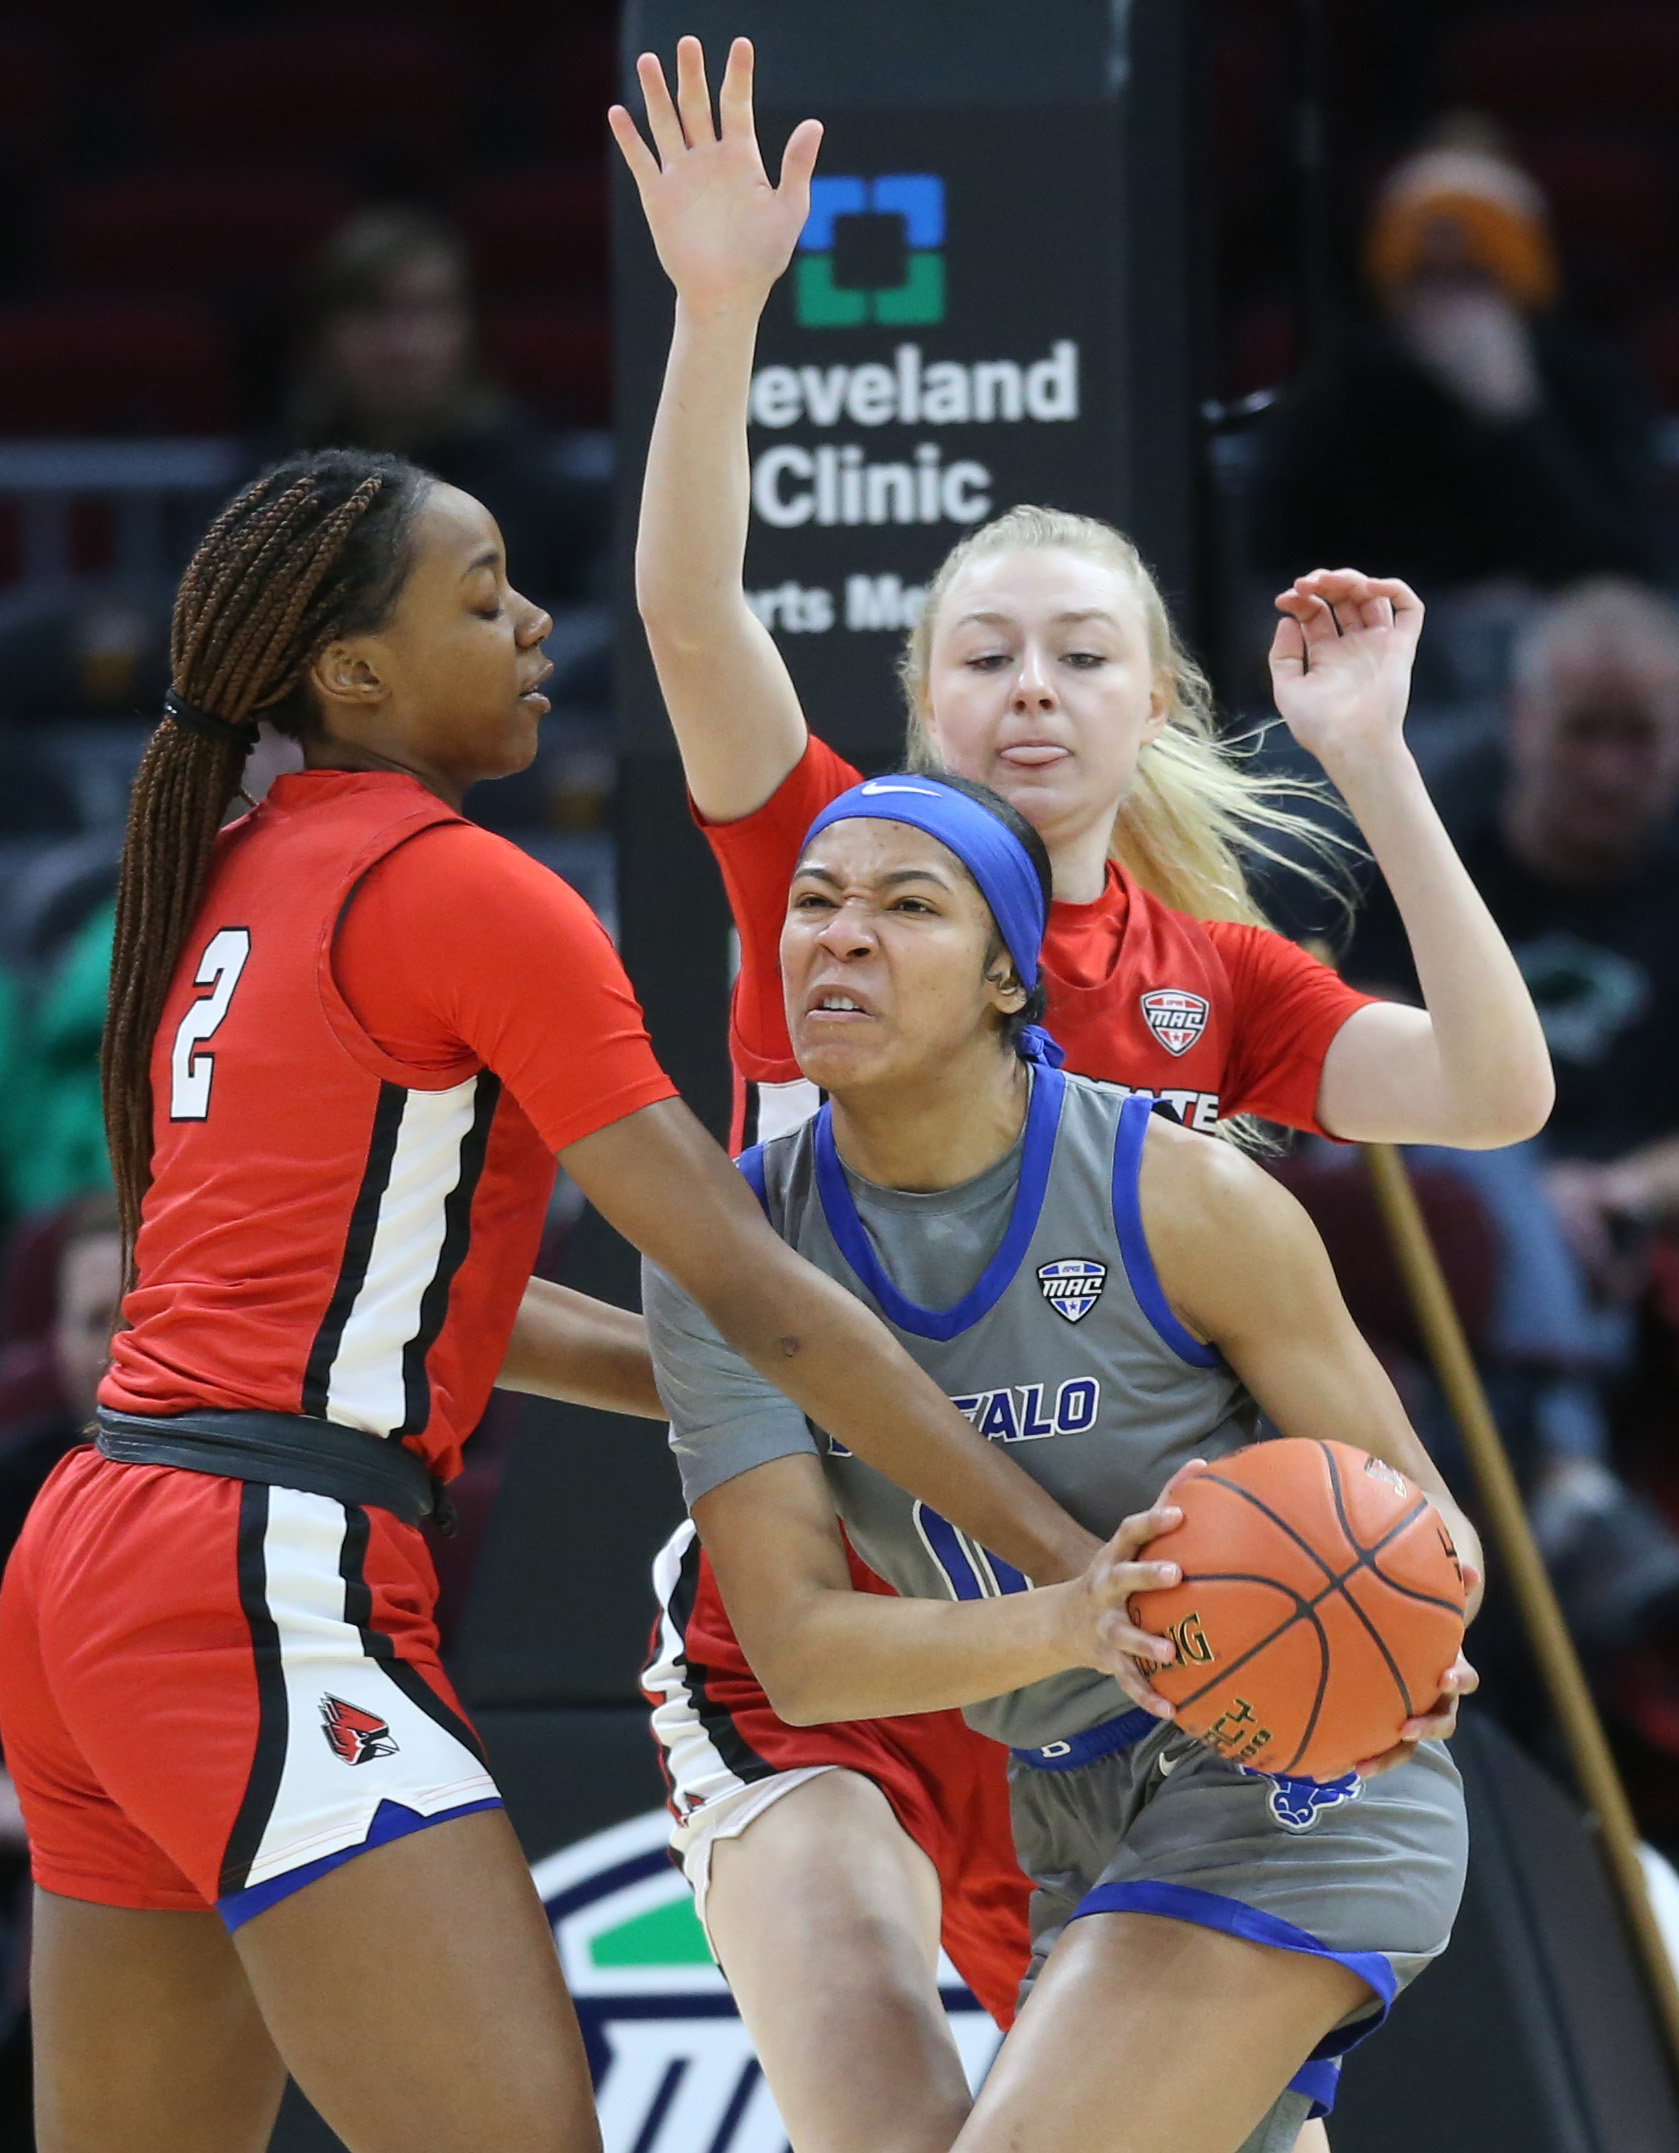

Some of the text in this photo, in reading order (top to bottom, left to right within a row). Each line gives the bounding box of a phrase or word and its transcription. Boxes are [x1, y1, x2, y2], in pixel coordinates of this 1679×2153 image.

[748, 339, 1081, 428] eveland
[753, 443, 992, 528] Clinic
[745, 580, 834, 632] rts
[170, 926, 251, 1122] 2
[1148, 1010, 1206, 1029] MAC
[1042, 1277, 1103, 1297] MAC
